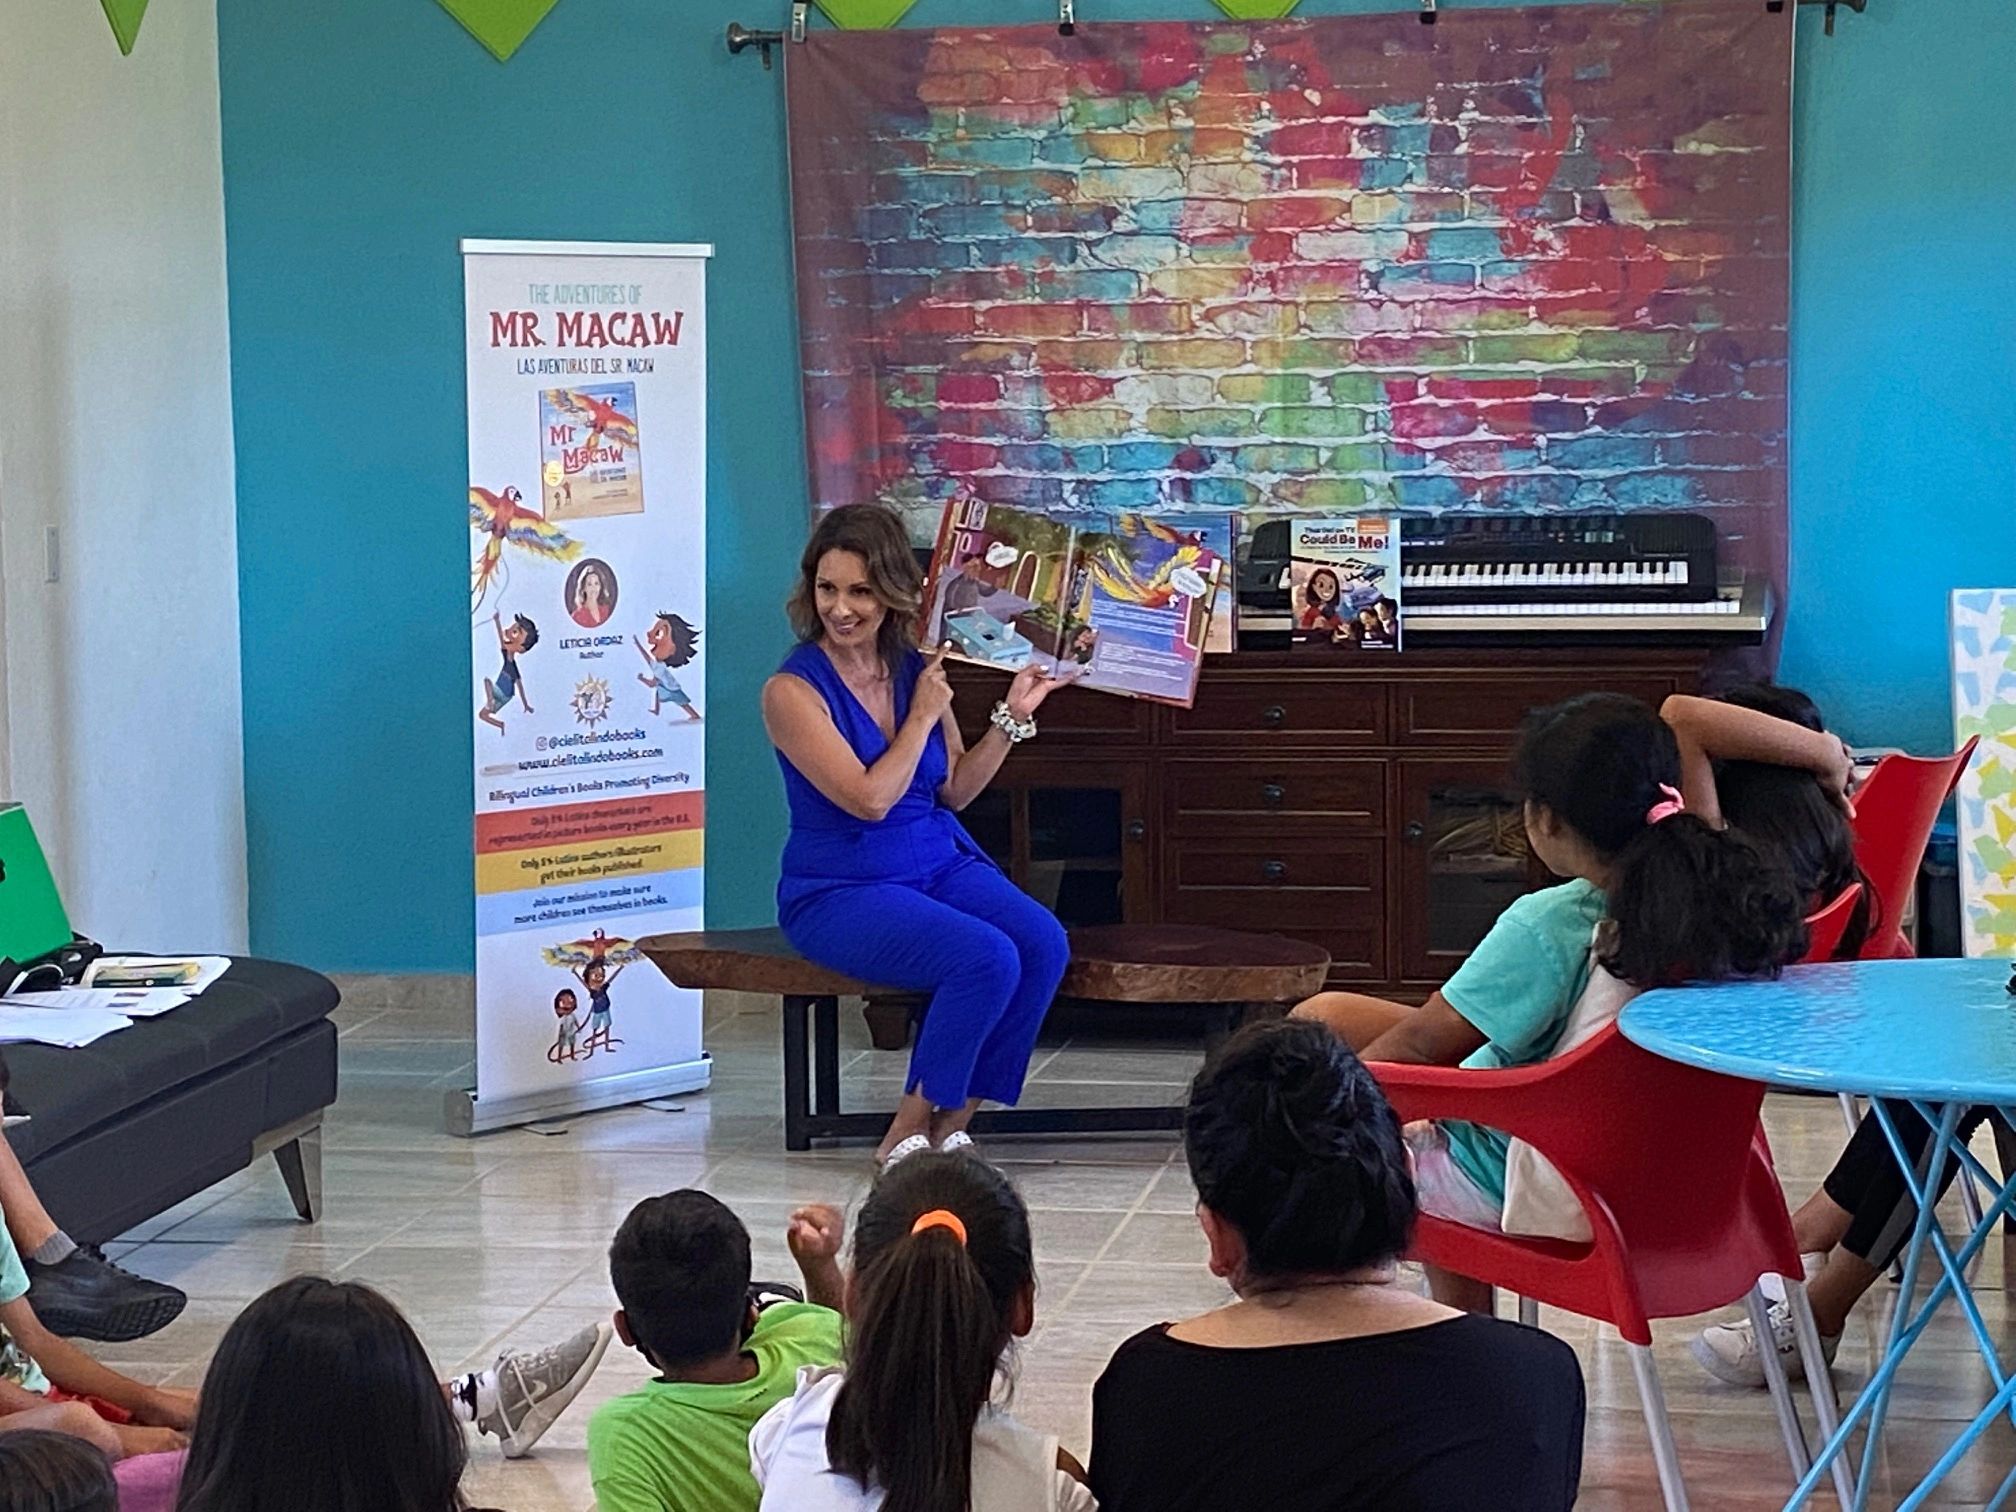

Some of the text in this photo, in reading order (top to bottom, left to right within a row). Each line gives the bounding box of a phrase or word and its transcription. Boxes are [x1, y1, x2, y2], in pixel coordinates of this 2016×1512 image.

[529, 284, 642, 304] THE ADVENTURES OF
[556, 311, 684, 348] MACAW
[517, 358, 535, 374] LAS
[538, 358, 588, 374] AVENTURAS
[590, 358, 607, 374] DEL
[627, 358, 654, 373] MACAW
[1300, 533, 1337, 544] Could
[1339, 533, 1356, 544] Be
[1358, 535, 1389, 549] Me!
[560, 637, 592, 649] LETICIA
[518, 747, 664, 771] www.cielitolindobooks.com
[489, 771, 690, 804] Bilingual Children's Books Promoting Diversity
[551, 895, 566, 905] our
[598, 890, 608, 899] to
[632, 885, 652, 894] sure
[514, 914, 537, 924] more
[538, 908, 571, 921] children
[572, 908, 586, 917] see
